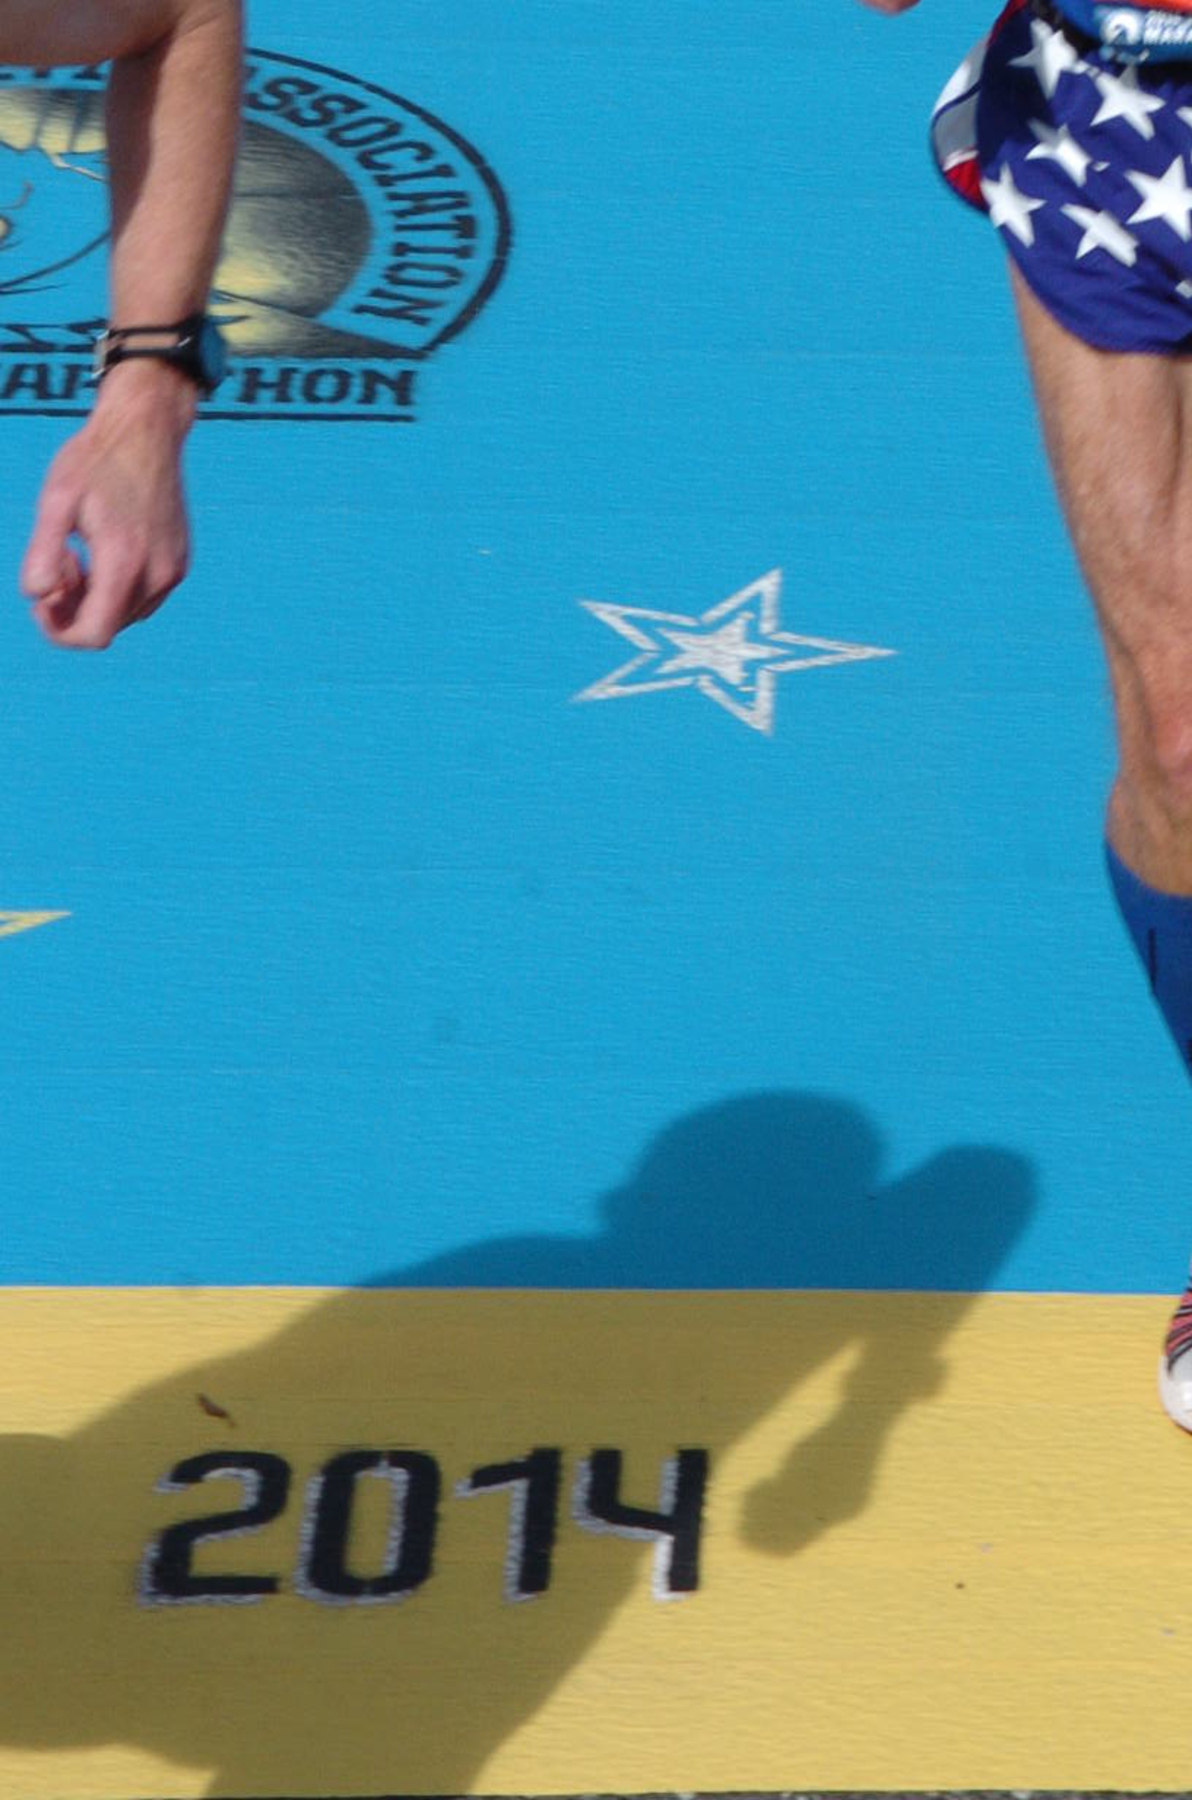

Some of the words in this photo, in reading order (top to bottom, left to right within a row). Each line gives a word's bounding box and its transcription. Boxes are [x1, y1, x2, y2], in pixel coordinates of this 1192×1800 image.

[248, 74, 478, 325] SSOCIATION
[3, 363, 418, 406] AHON
[142, 1447, 712, 1608] 2014
